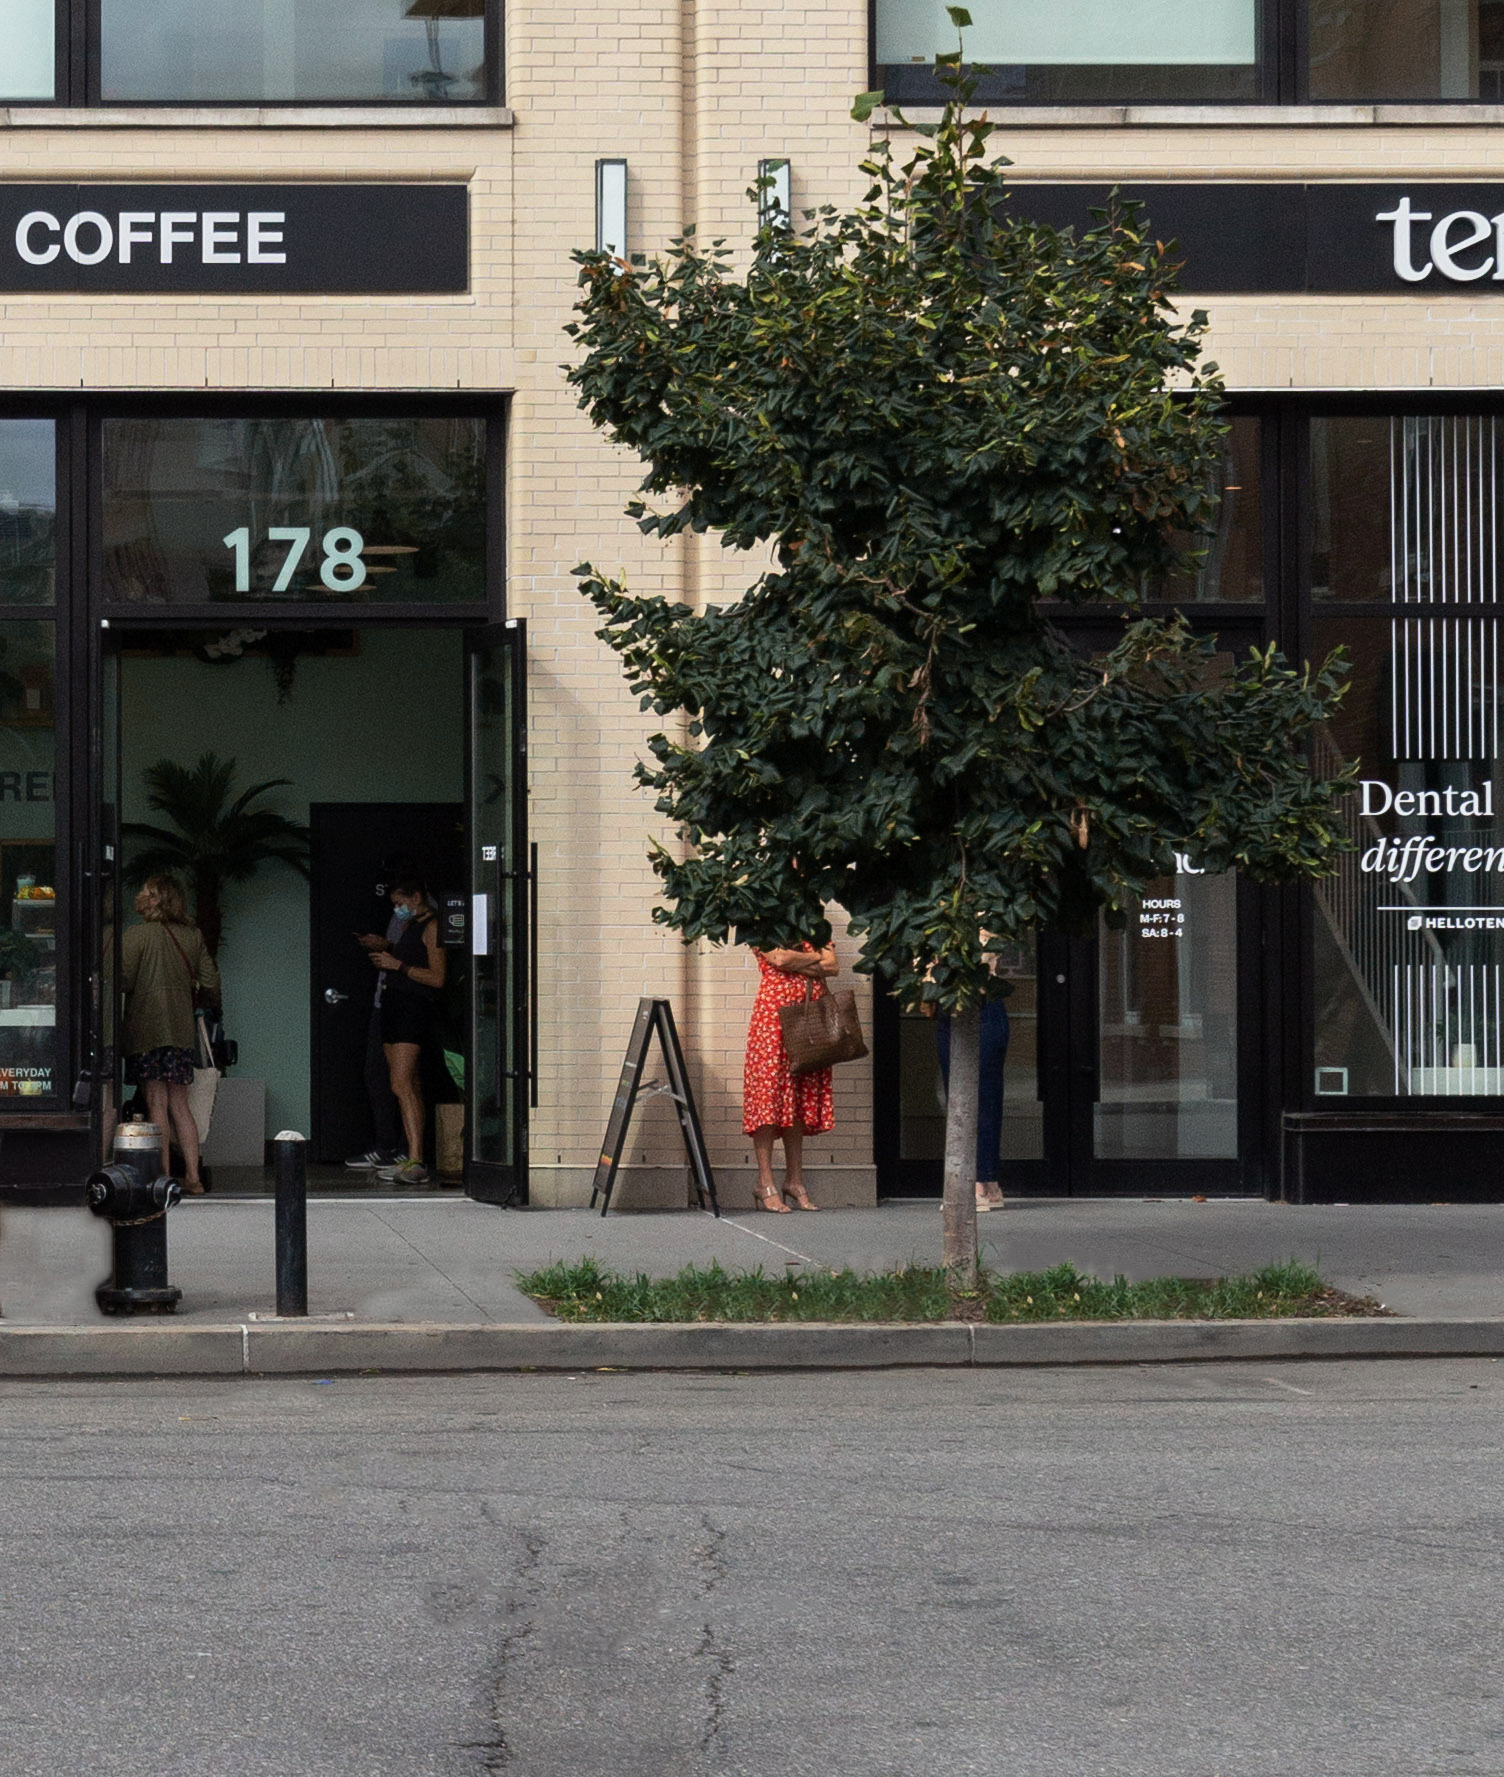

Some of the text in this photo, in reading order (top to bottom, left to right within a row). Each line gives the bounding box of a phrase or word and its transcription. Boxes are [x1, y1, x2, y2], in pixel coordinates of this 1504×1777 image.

[15, 210, 287, 266] COFFEE
[1375, 196, 1504, 282] te
[222, 526, 367, 592] 178
[1359, 780, 1495, 817] Dental
[1360, 835, 1504, 883] differen
[1142, 898, 1182, 909] HOURS
